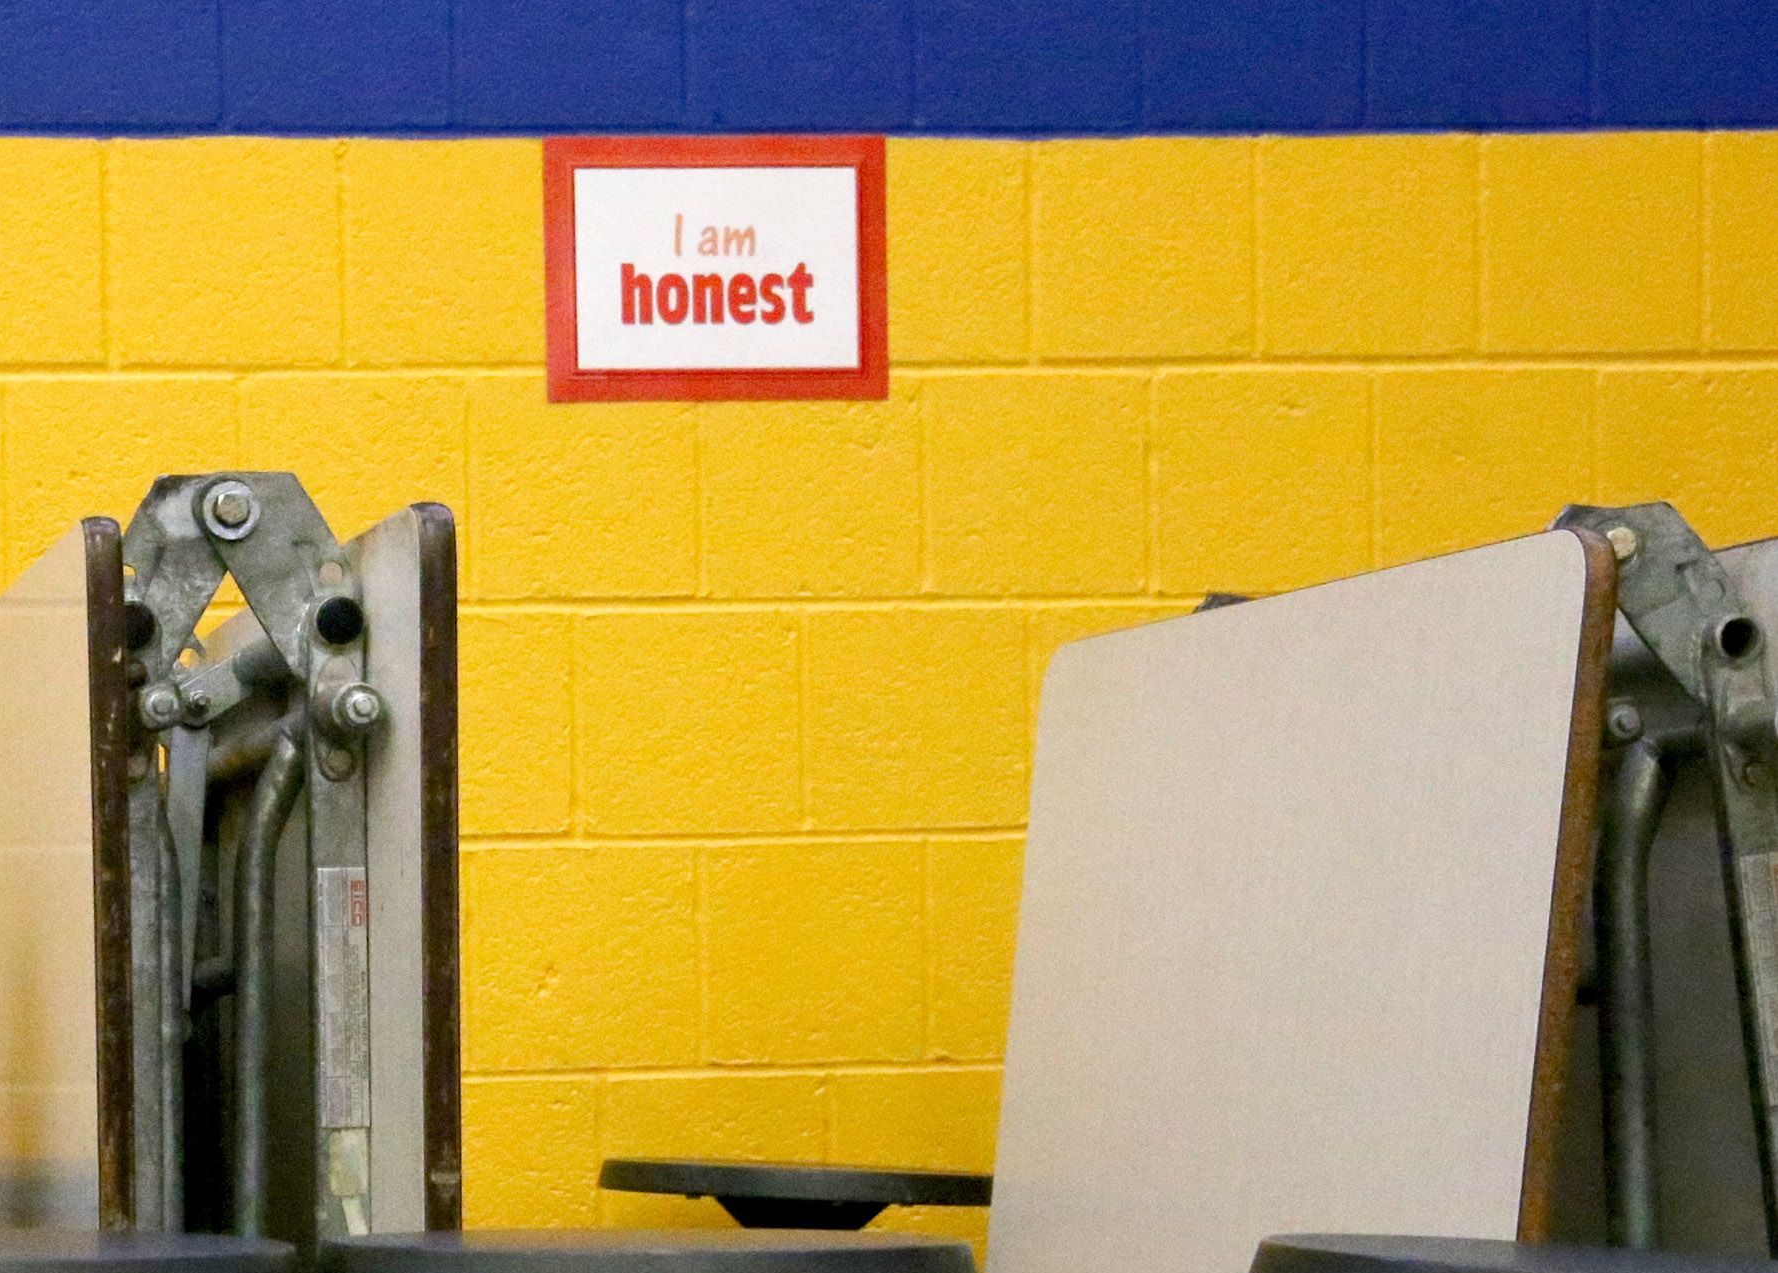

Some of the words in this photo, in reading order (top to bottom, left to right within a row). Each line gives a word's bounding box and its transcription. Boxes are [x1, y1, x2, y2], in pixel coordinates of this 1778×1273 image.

[674, 213, 683, 256] I
[697, 225, 757, 256] am
[621, 262, 814, 325] honest
